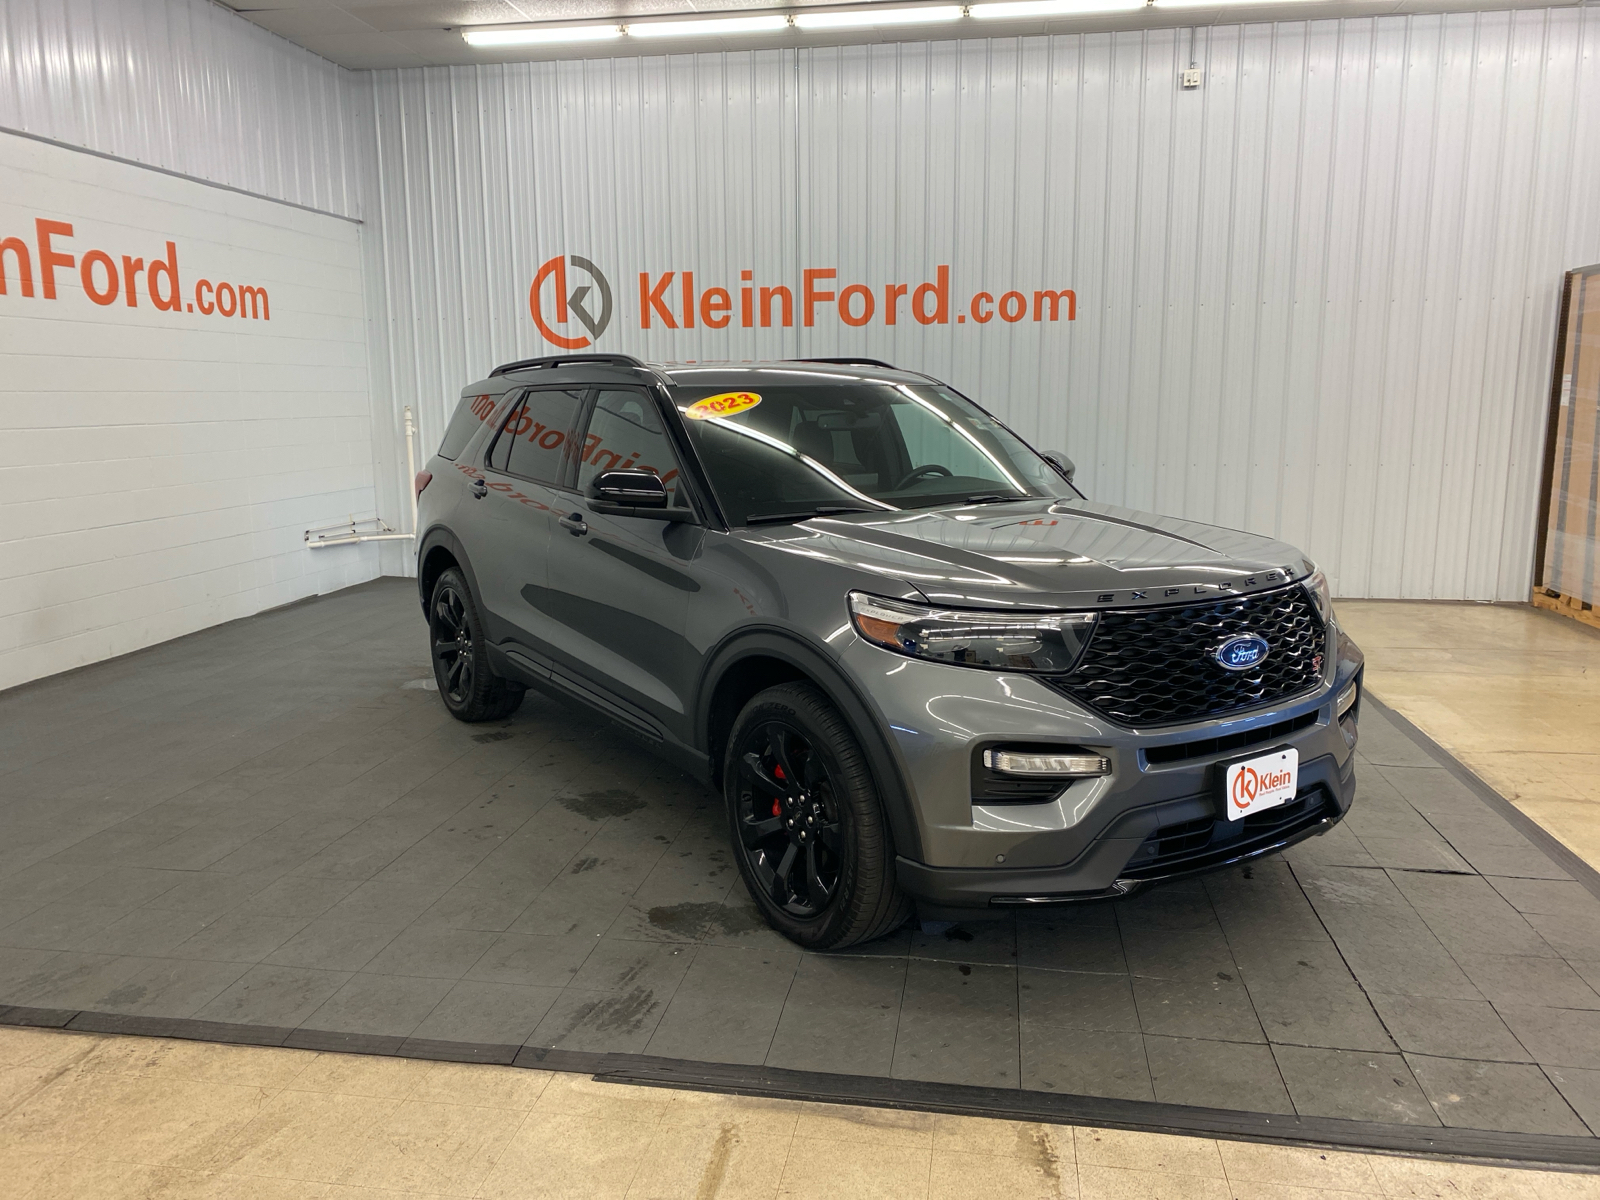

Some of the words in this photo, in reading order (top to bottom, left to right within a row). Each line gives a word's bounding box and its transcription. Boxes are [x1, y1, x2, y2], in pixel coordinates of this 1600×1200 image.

[638, 264, 1077, 329] KleinFord.com
[694, 393, 755, 418] 2023
[1096, 565, 1296, 603] EXPLORER
[1231, 641, 1261, 664] Ford
[1259, 769, 1291, 793] Klein
